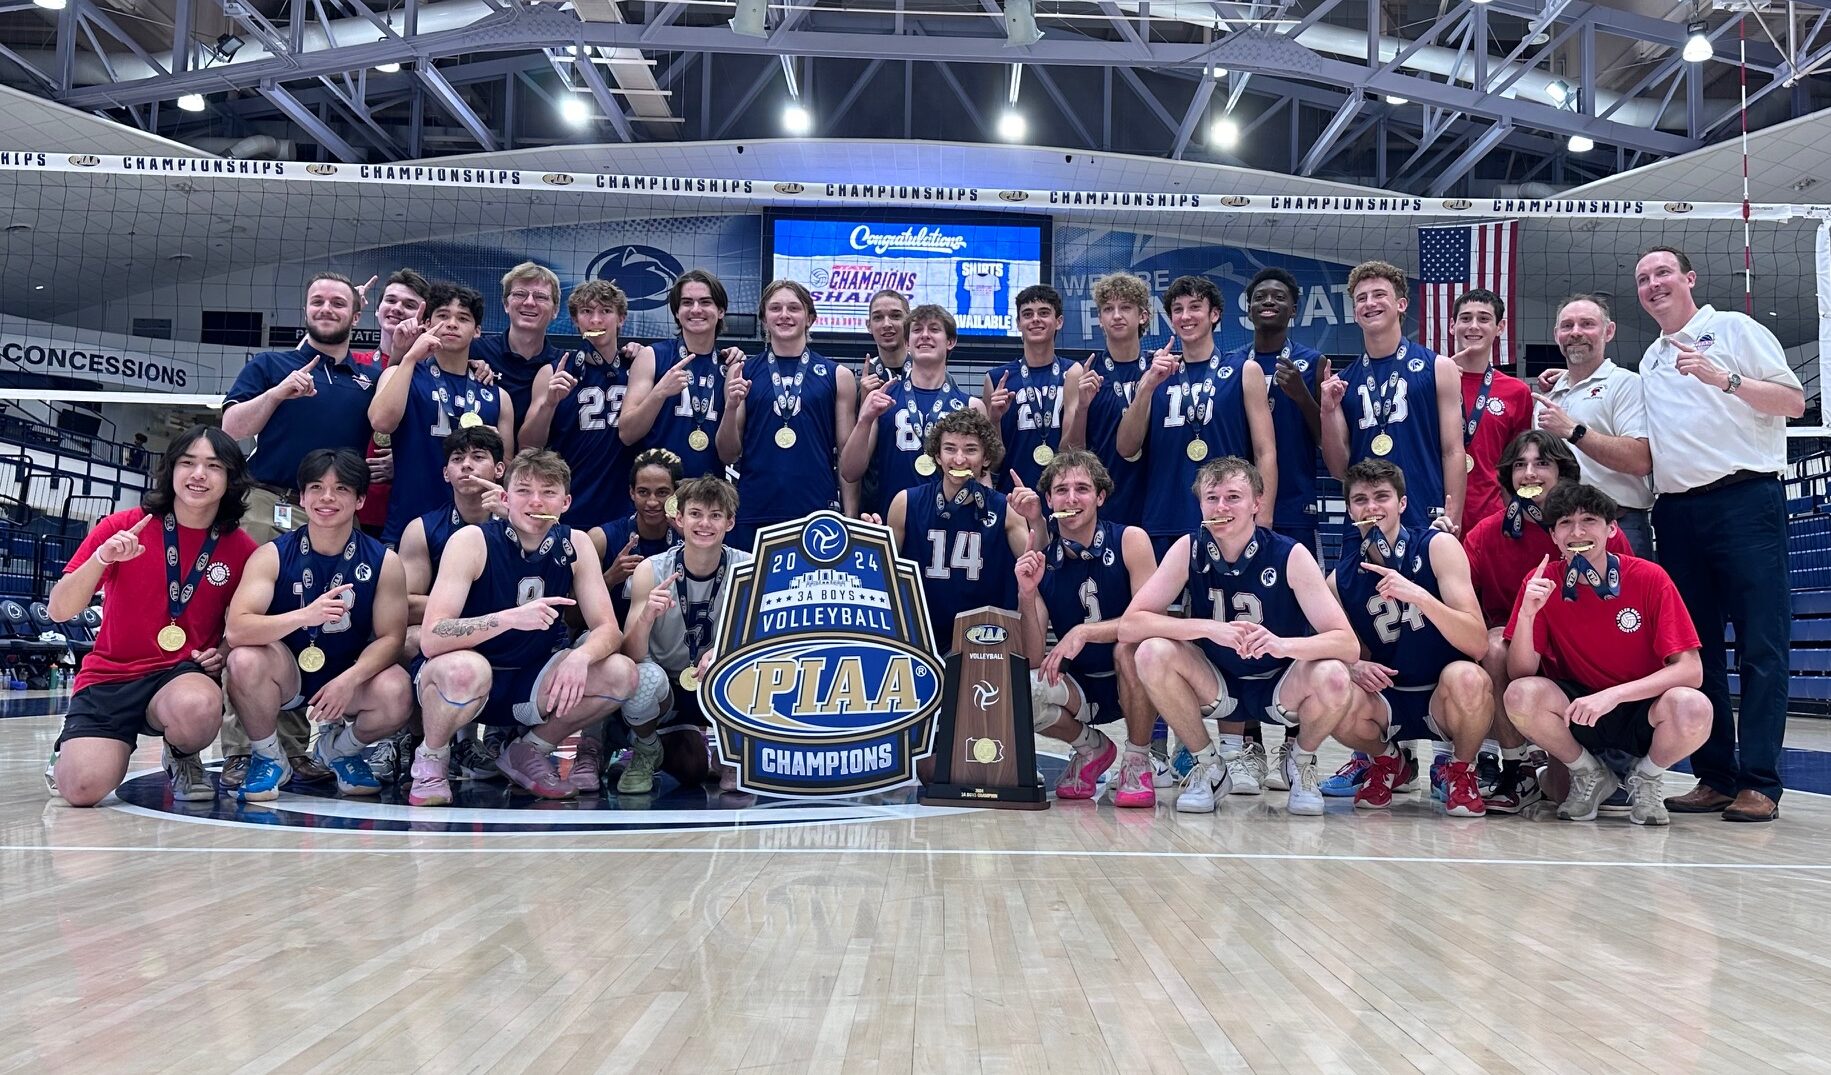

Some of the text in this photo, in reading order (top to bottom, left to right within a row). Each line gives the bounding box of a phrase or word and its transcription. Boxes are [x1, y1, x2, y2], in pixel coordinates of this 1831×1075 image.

[123, 157, 284, 174] CHAMPIONSHIPS
[360, 165, 520, 184] CHAMPIONSHIPS
[596, 175, 752, 193] CHAMPIONSHIPS
[826, 183, 978, 201] CHAMPIONSHIPS
[1050, 191, 1199, 207] CHAMPIONSHIPS
[1271, 196, 1422, 211] CHAMPIONSHIPS
[1493, 200, 1644, 213] CHAMPIONSHIPS
[850, 225, 967, 254] Congratulations
[961, 262, 1004, 277] SHIRTS
[829, 270, 917, 291] CHAMPIONS
[3, 343, 187, 387] CONCESSIONS
[772, 551, 878, 573] 20 24
[925, 529, 983, 580] 14
[797, 589, 855, 602] 3A BOYS
[763, 607, 891, 632] VOLLEYBALL
[969, 652, 1004, 660] VOLLEYBALL
[747, 655, 921, 717] PIAA
[761, 743, 892, 776] CHAMPIONS
